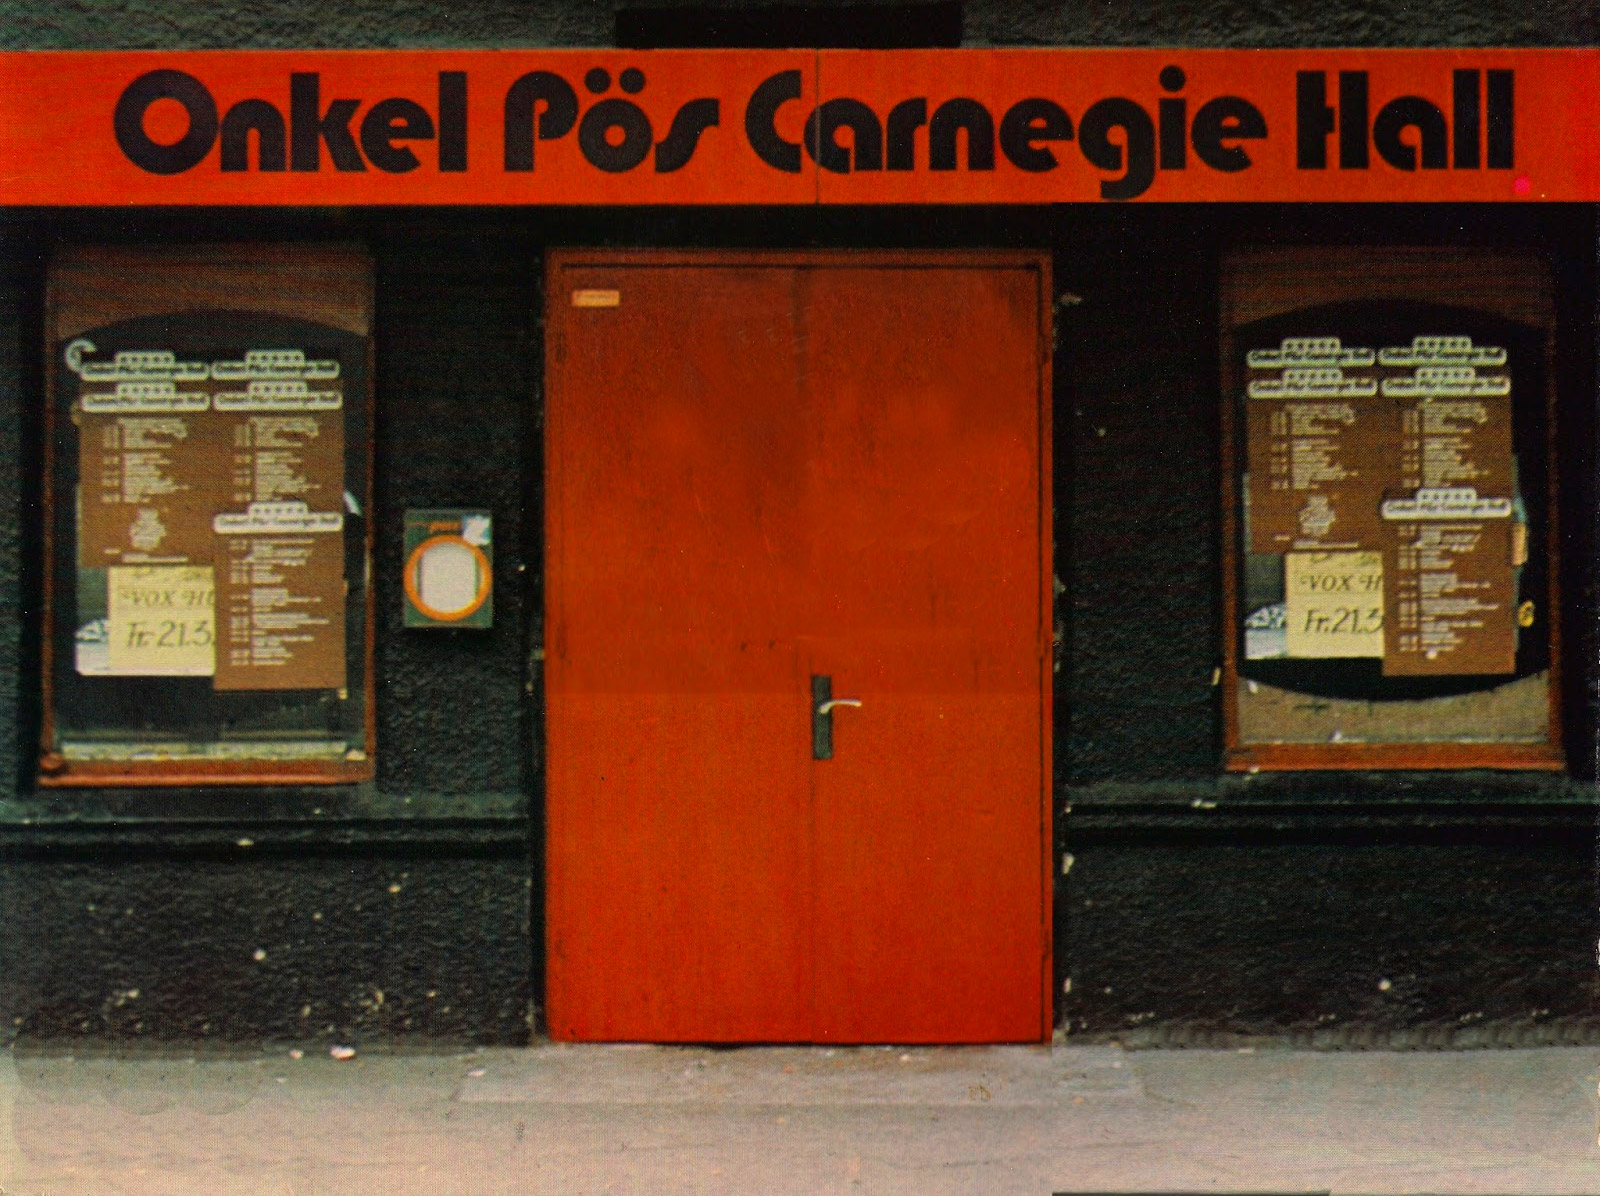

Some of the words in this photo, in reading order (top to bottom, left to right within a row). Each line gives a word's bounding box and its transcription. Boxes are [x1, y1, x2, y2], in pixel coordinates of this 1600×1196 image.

[113, 69, 468, 175] Onkel
[504, 66, 721, 174] Pös
[744, 65, 1269, 200] Carnegie
[1296, 68, 1515, 172] Hall
